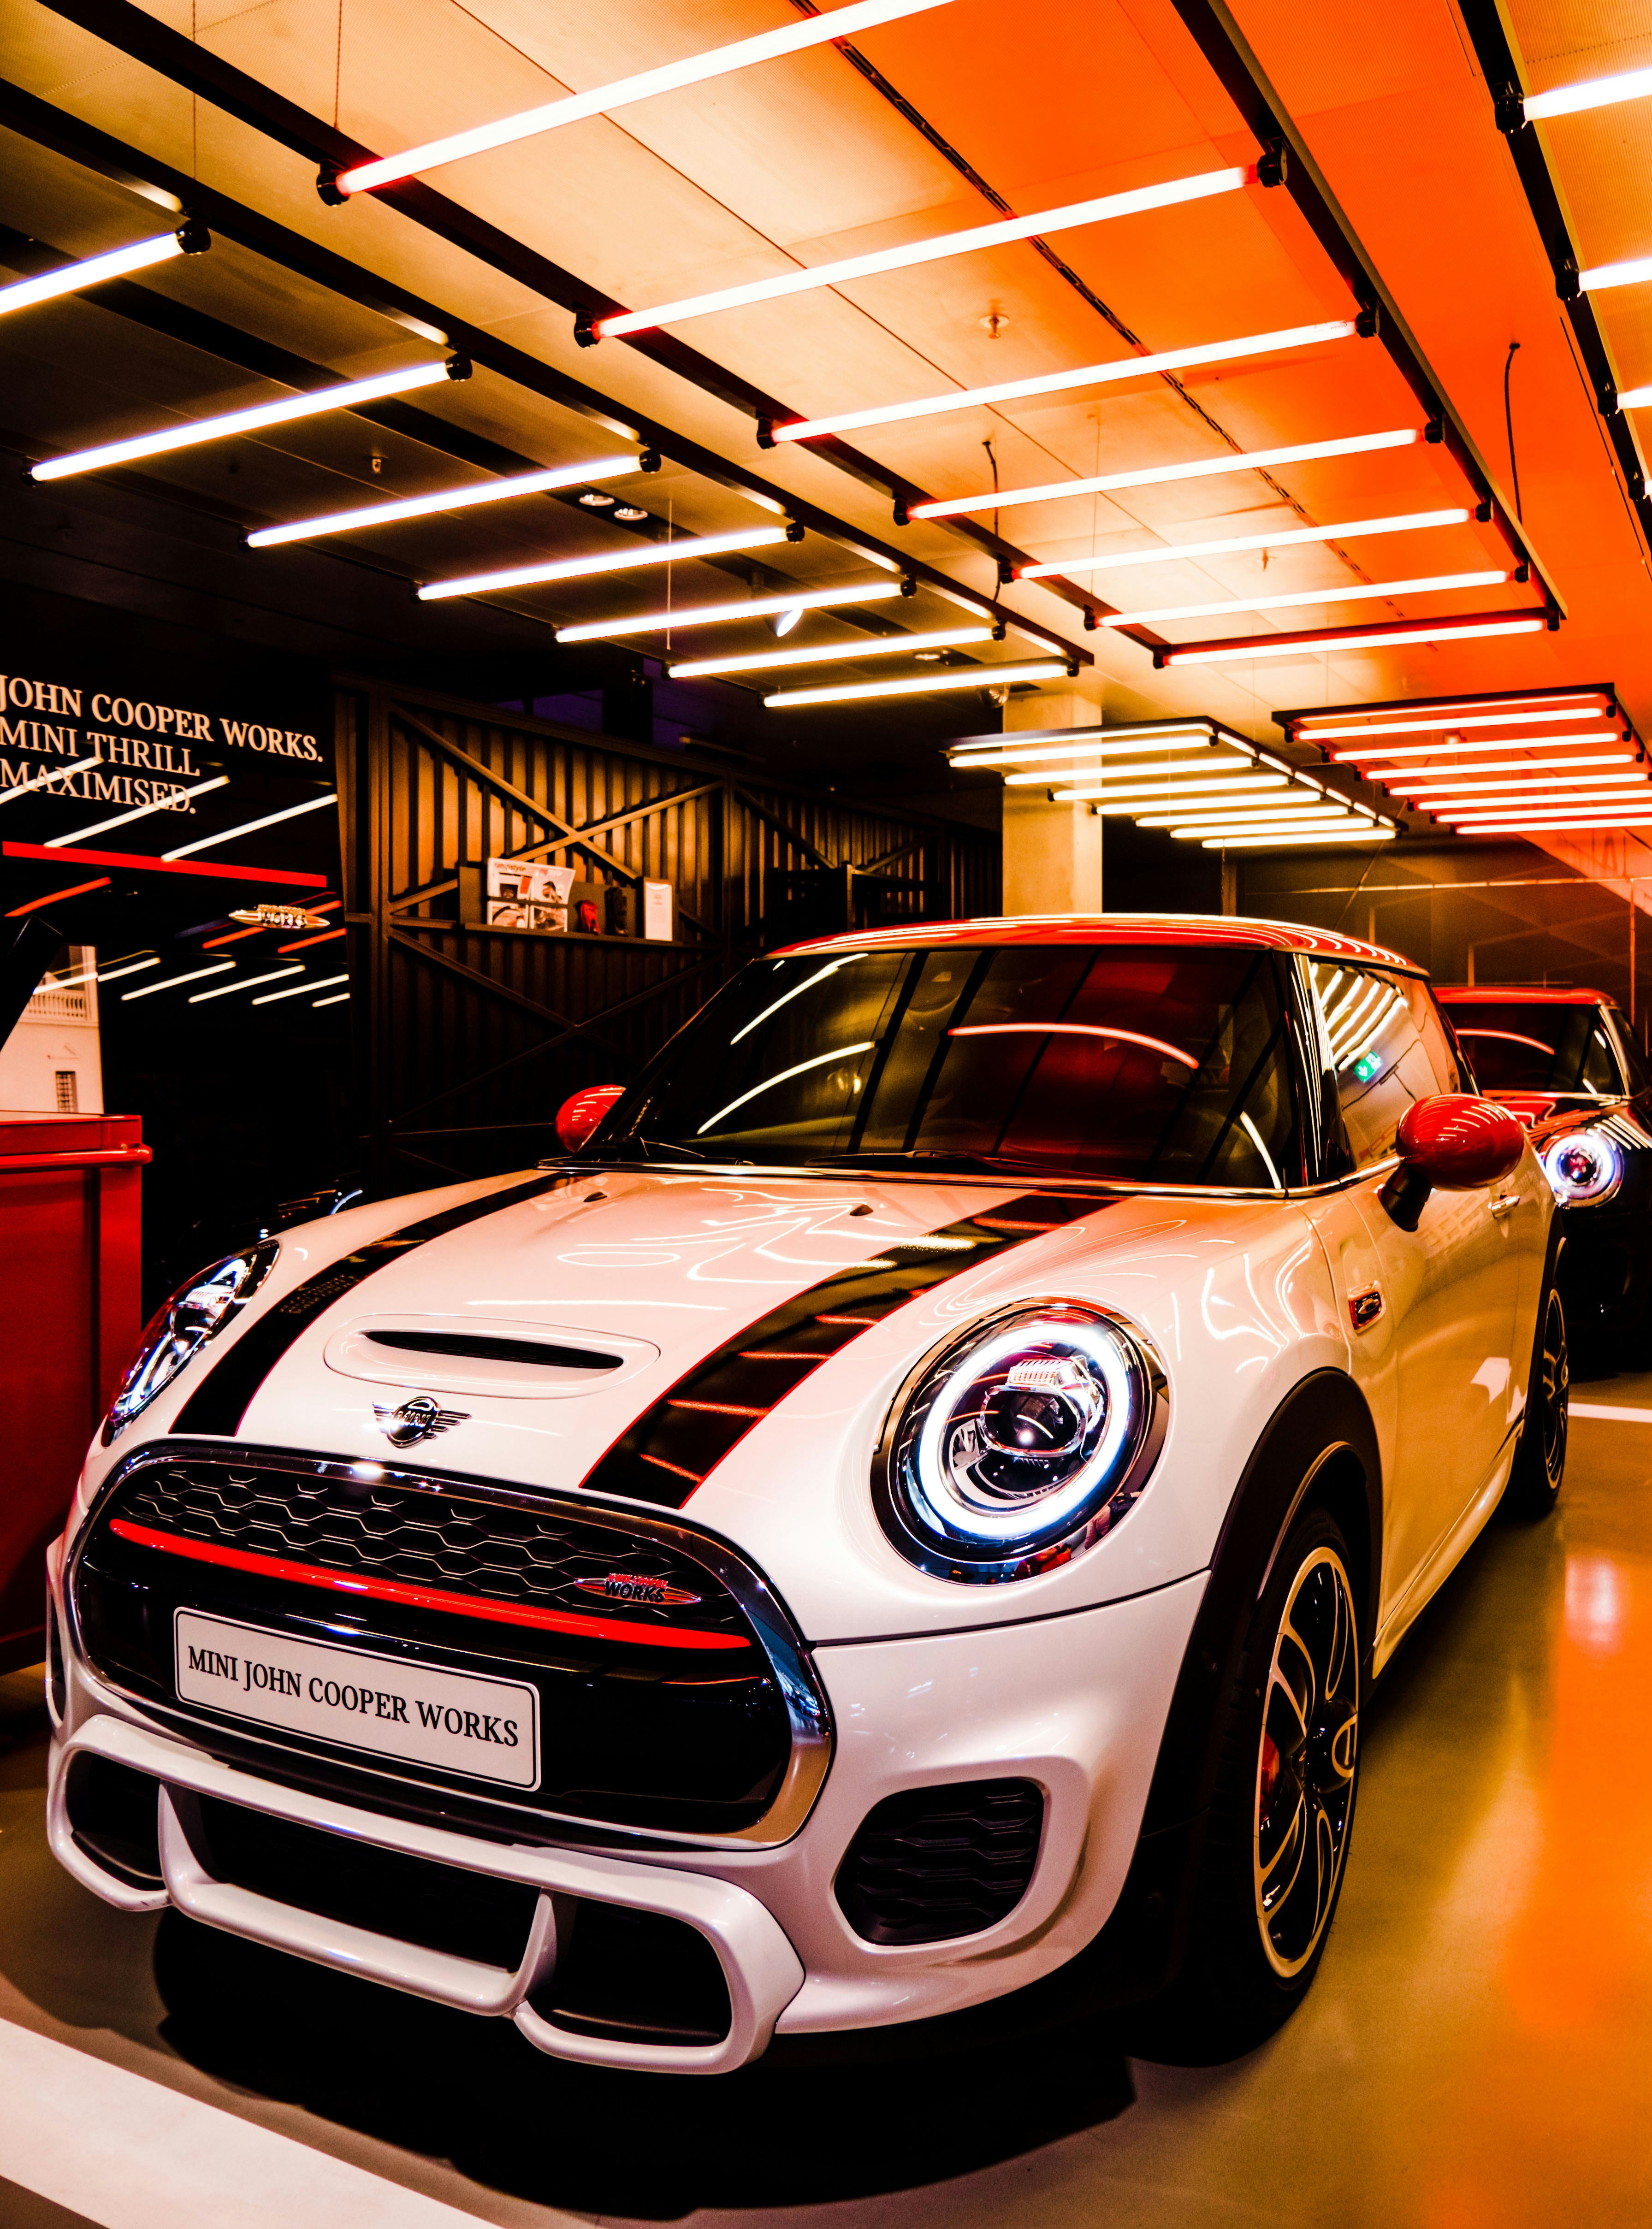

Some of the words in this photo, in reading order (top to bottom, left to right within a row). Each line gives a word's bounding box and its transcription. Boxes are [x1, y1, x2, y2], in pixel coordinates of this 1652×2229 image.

[0, 674, 83, 717] JOHN
[91, 693, 214, 742] COOPER
[219, 718, 324, 762] WORKS.
[0, 716, 79, 757] MINI
[87, 731, 200, 777] THRILL
[0, 758, 196, 814] MAXIMISED.
[605, 1581, 665, 1602] WORKS
[189, 1645, 238, 1681] MINI
[243, 1660, 302, 1697] JOHN
[309, 1678, 410, 1724] COOPER
[415, 1700, 519, 1747] WORKS
